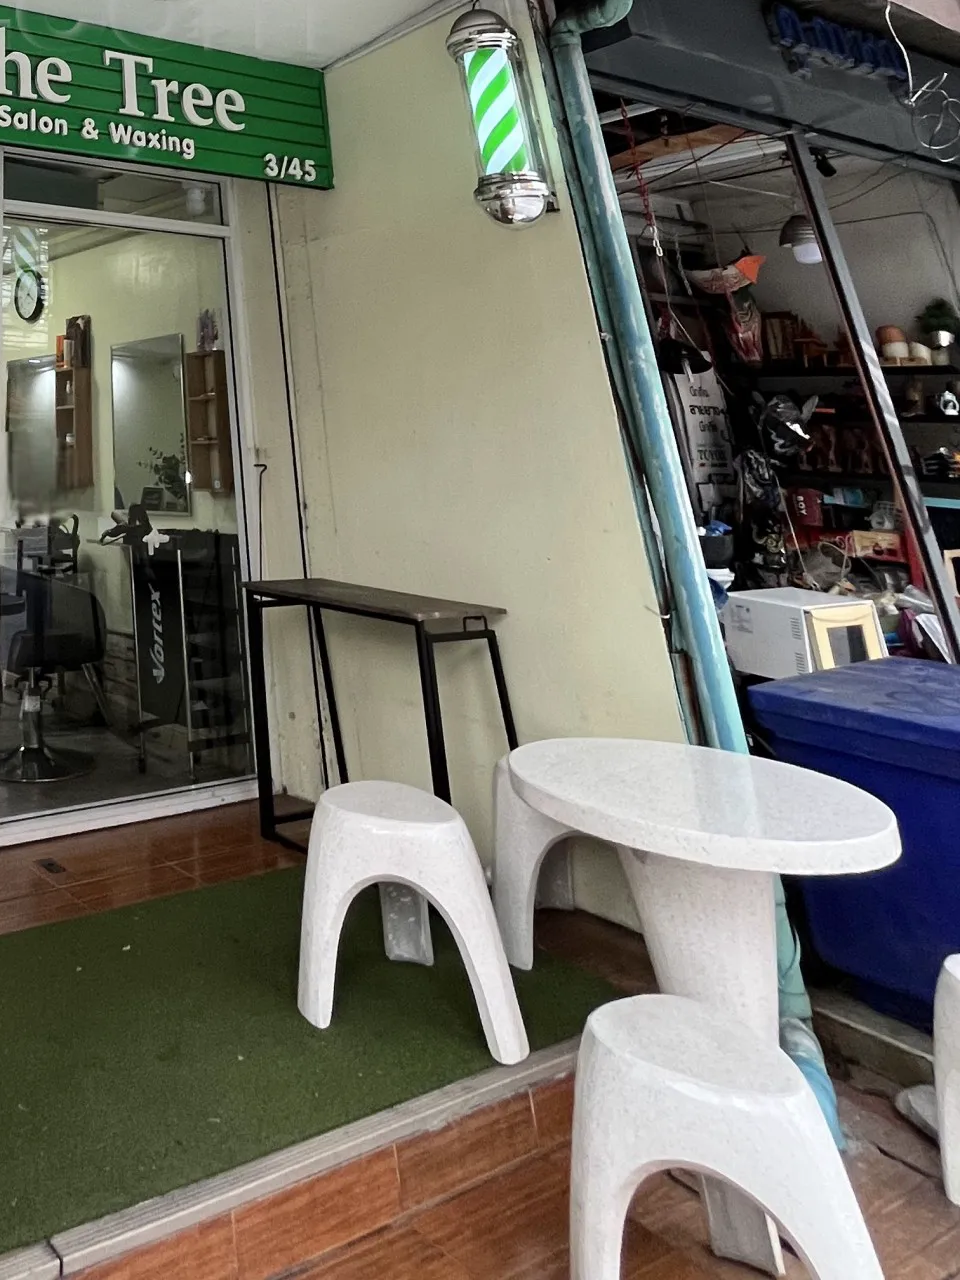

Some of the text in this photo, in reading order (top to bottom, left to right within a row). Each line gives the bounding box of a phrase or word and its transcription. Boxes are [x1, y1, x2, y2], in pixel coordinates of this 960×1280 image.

[103, 49, 246, 132] Tree
[81, 118, 99, 140] &
[109, 122, 196, 160] Waxing
[263, 153, 317, 182] 3/45
